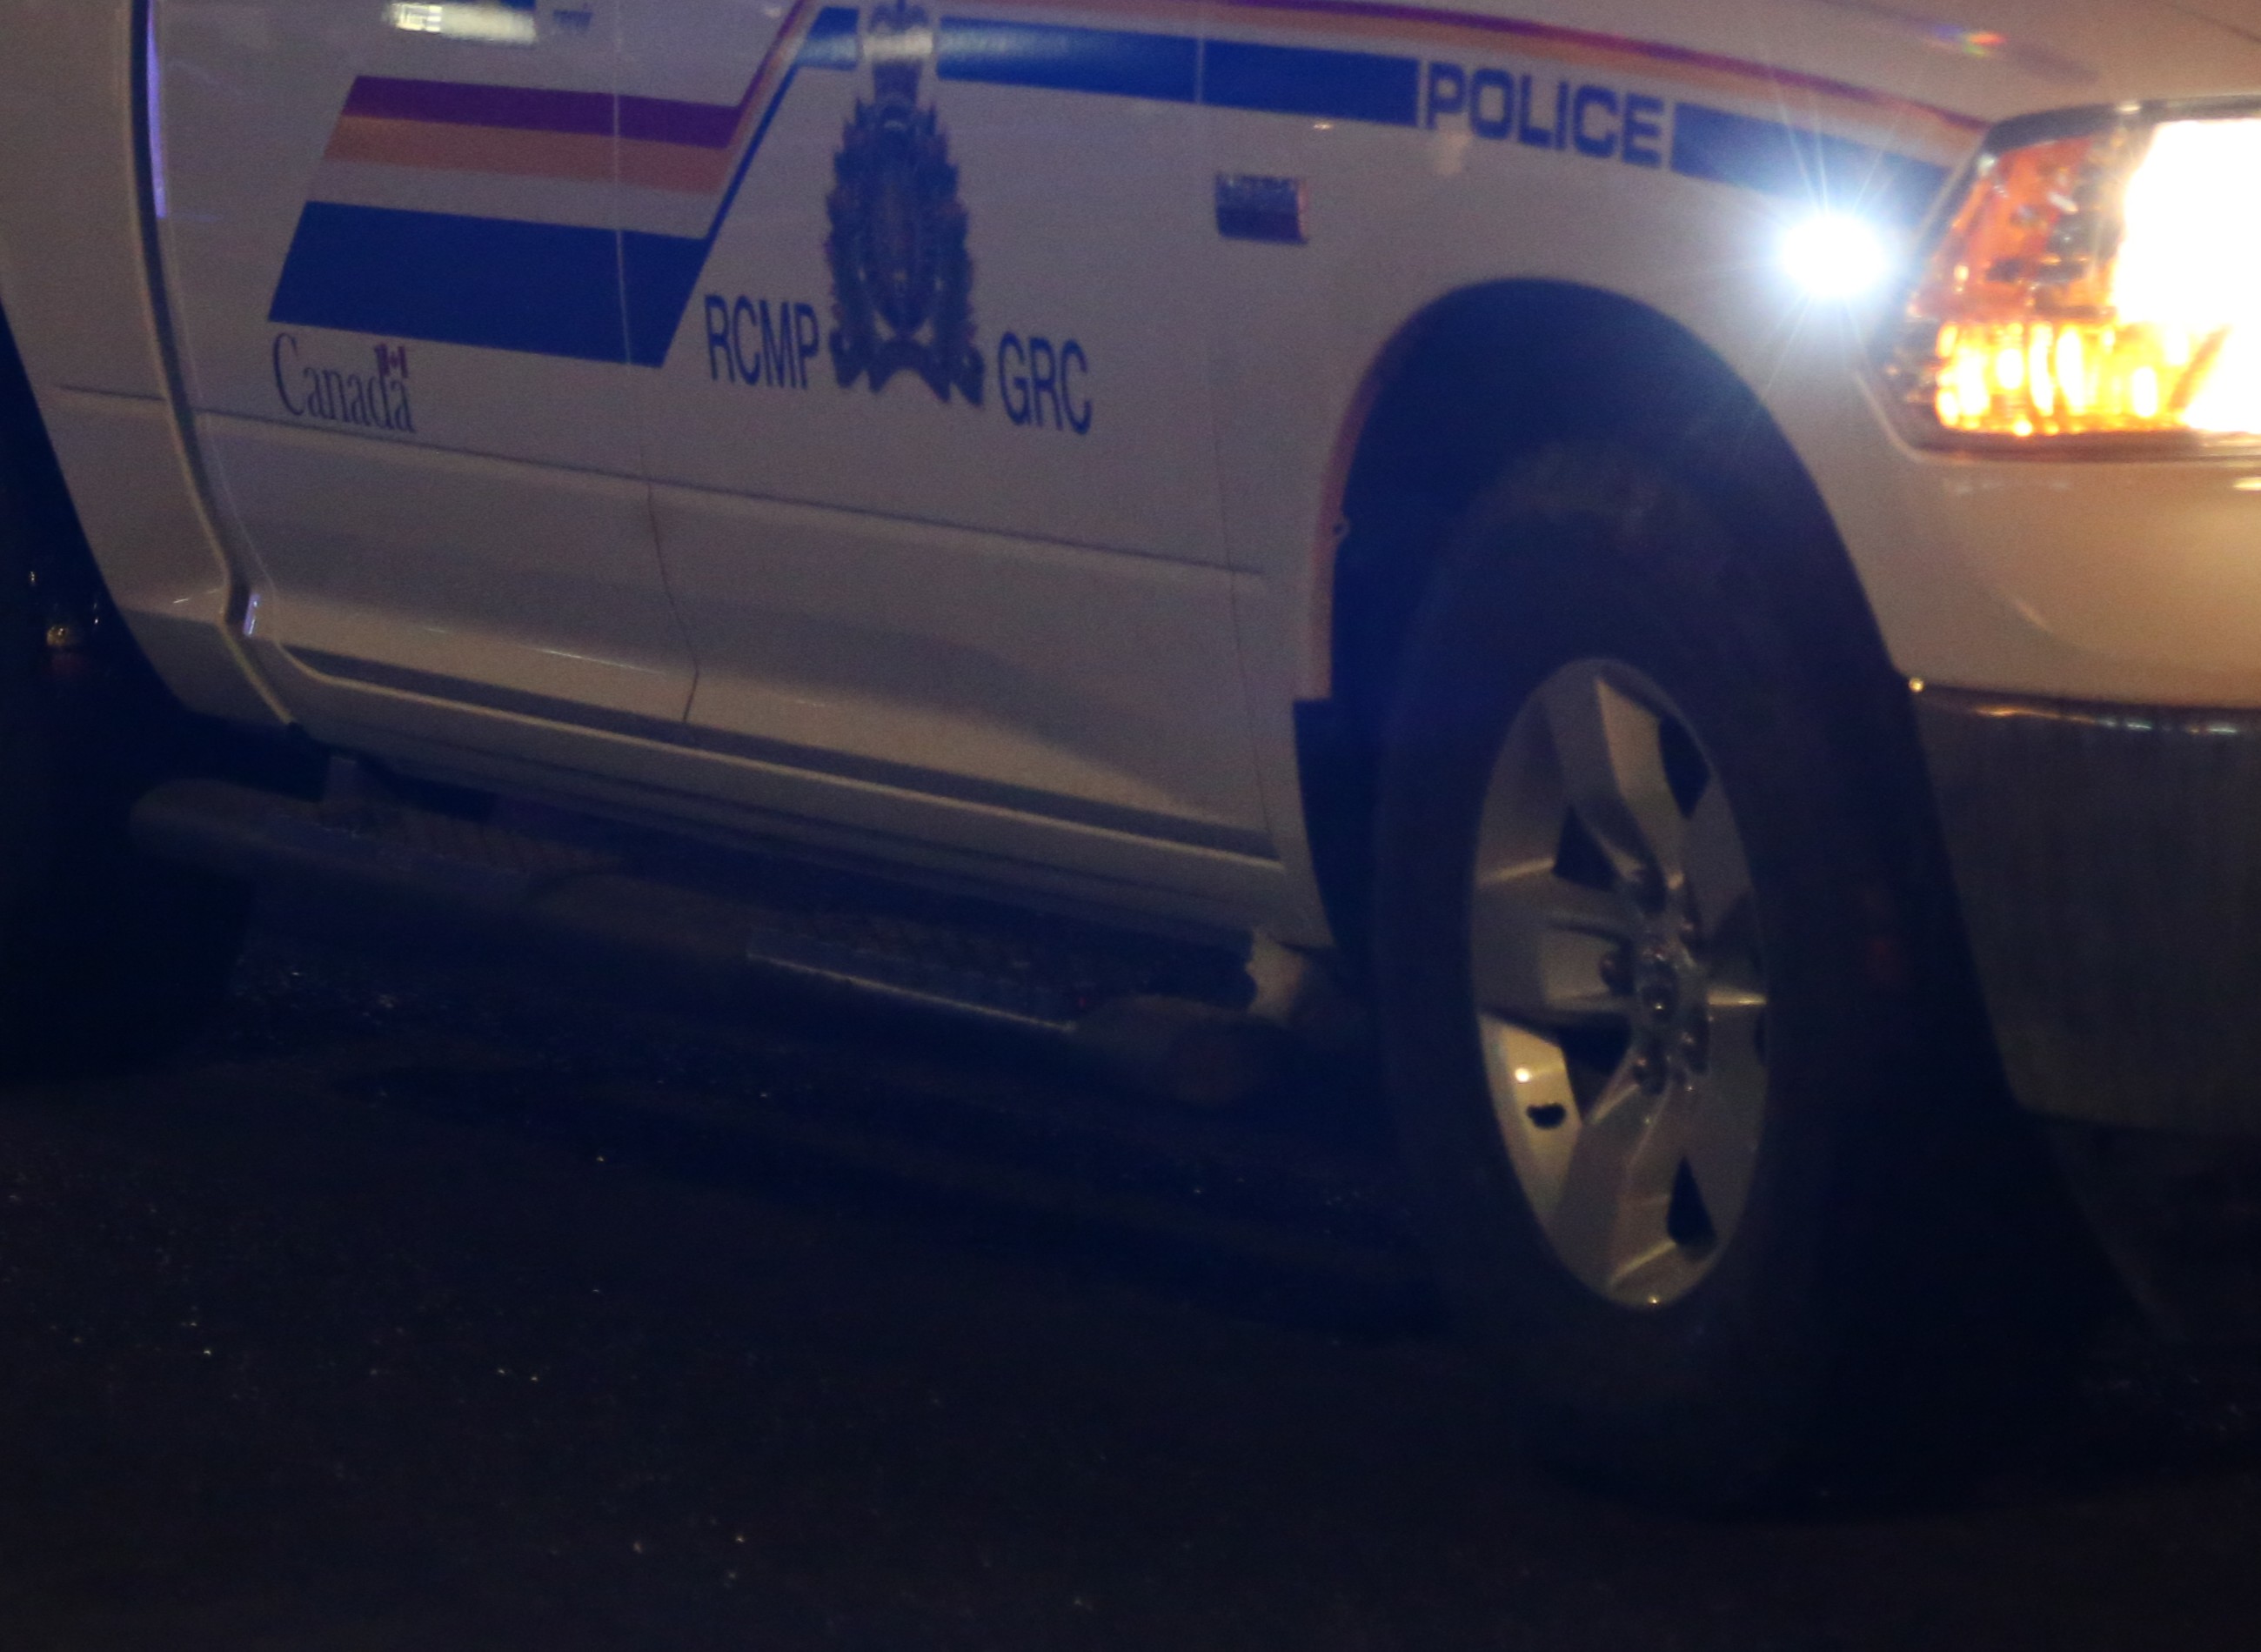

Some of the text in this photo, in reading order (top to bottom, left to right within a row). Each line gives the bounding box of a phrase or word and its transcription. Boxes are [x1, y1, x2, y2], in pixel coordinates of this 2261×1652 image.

[1427, 61, 1664, 169] POLICE
[273, 332, 415, 432] Canada
[706, 294, 1093, 434] RCMP GRC
